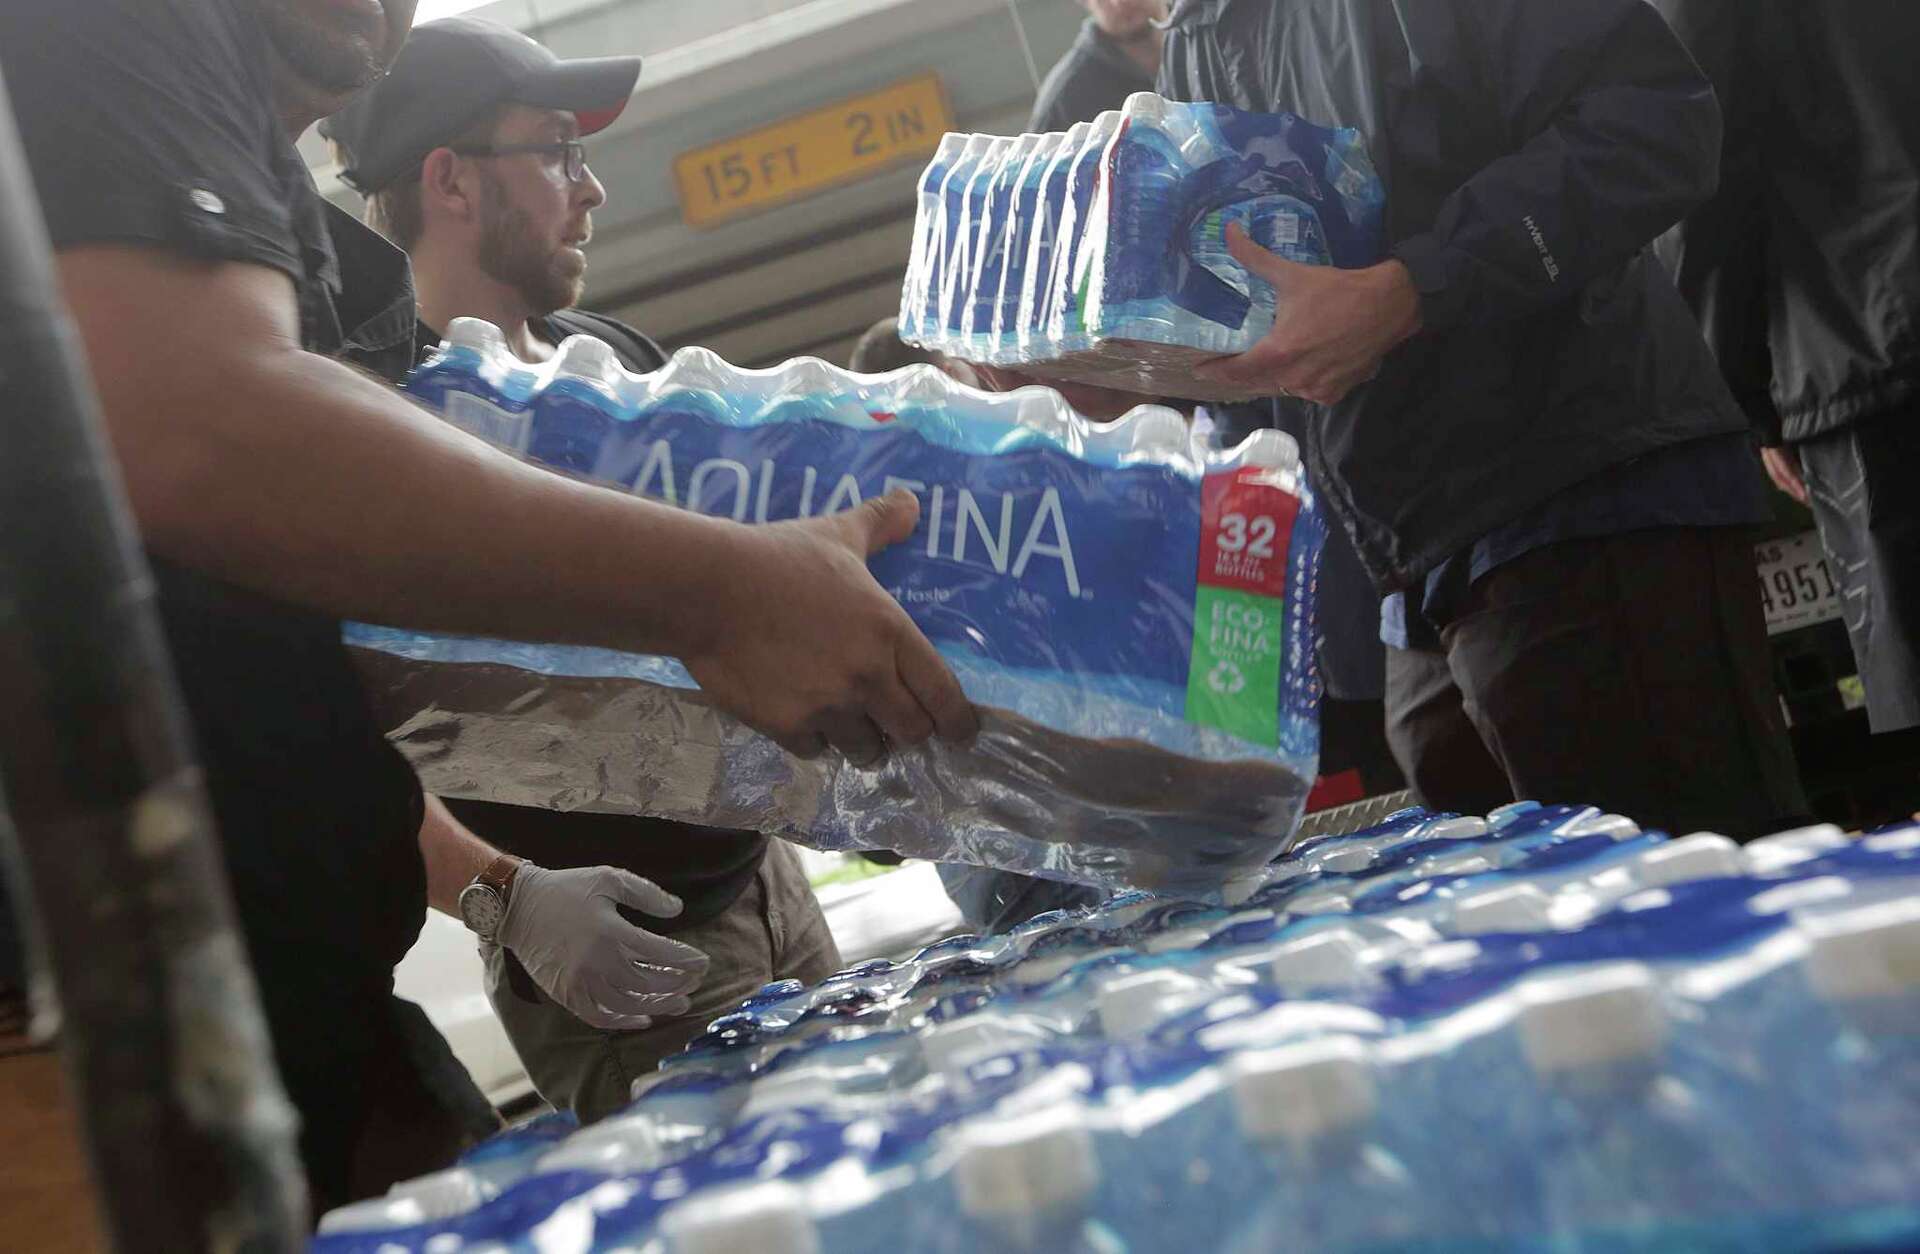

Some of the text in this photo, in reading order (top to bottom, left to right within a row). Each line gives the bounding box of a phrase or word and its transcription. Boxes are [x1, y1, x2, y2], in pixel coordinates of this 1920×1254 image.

[703, 106, 925, 200] 15 FT 2 IN
[1216, 513, 1276, 558] 32
